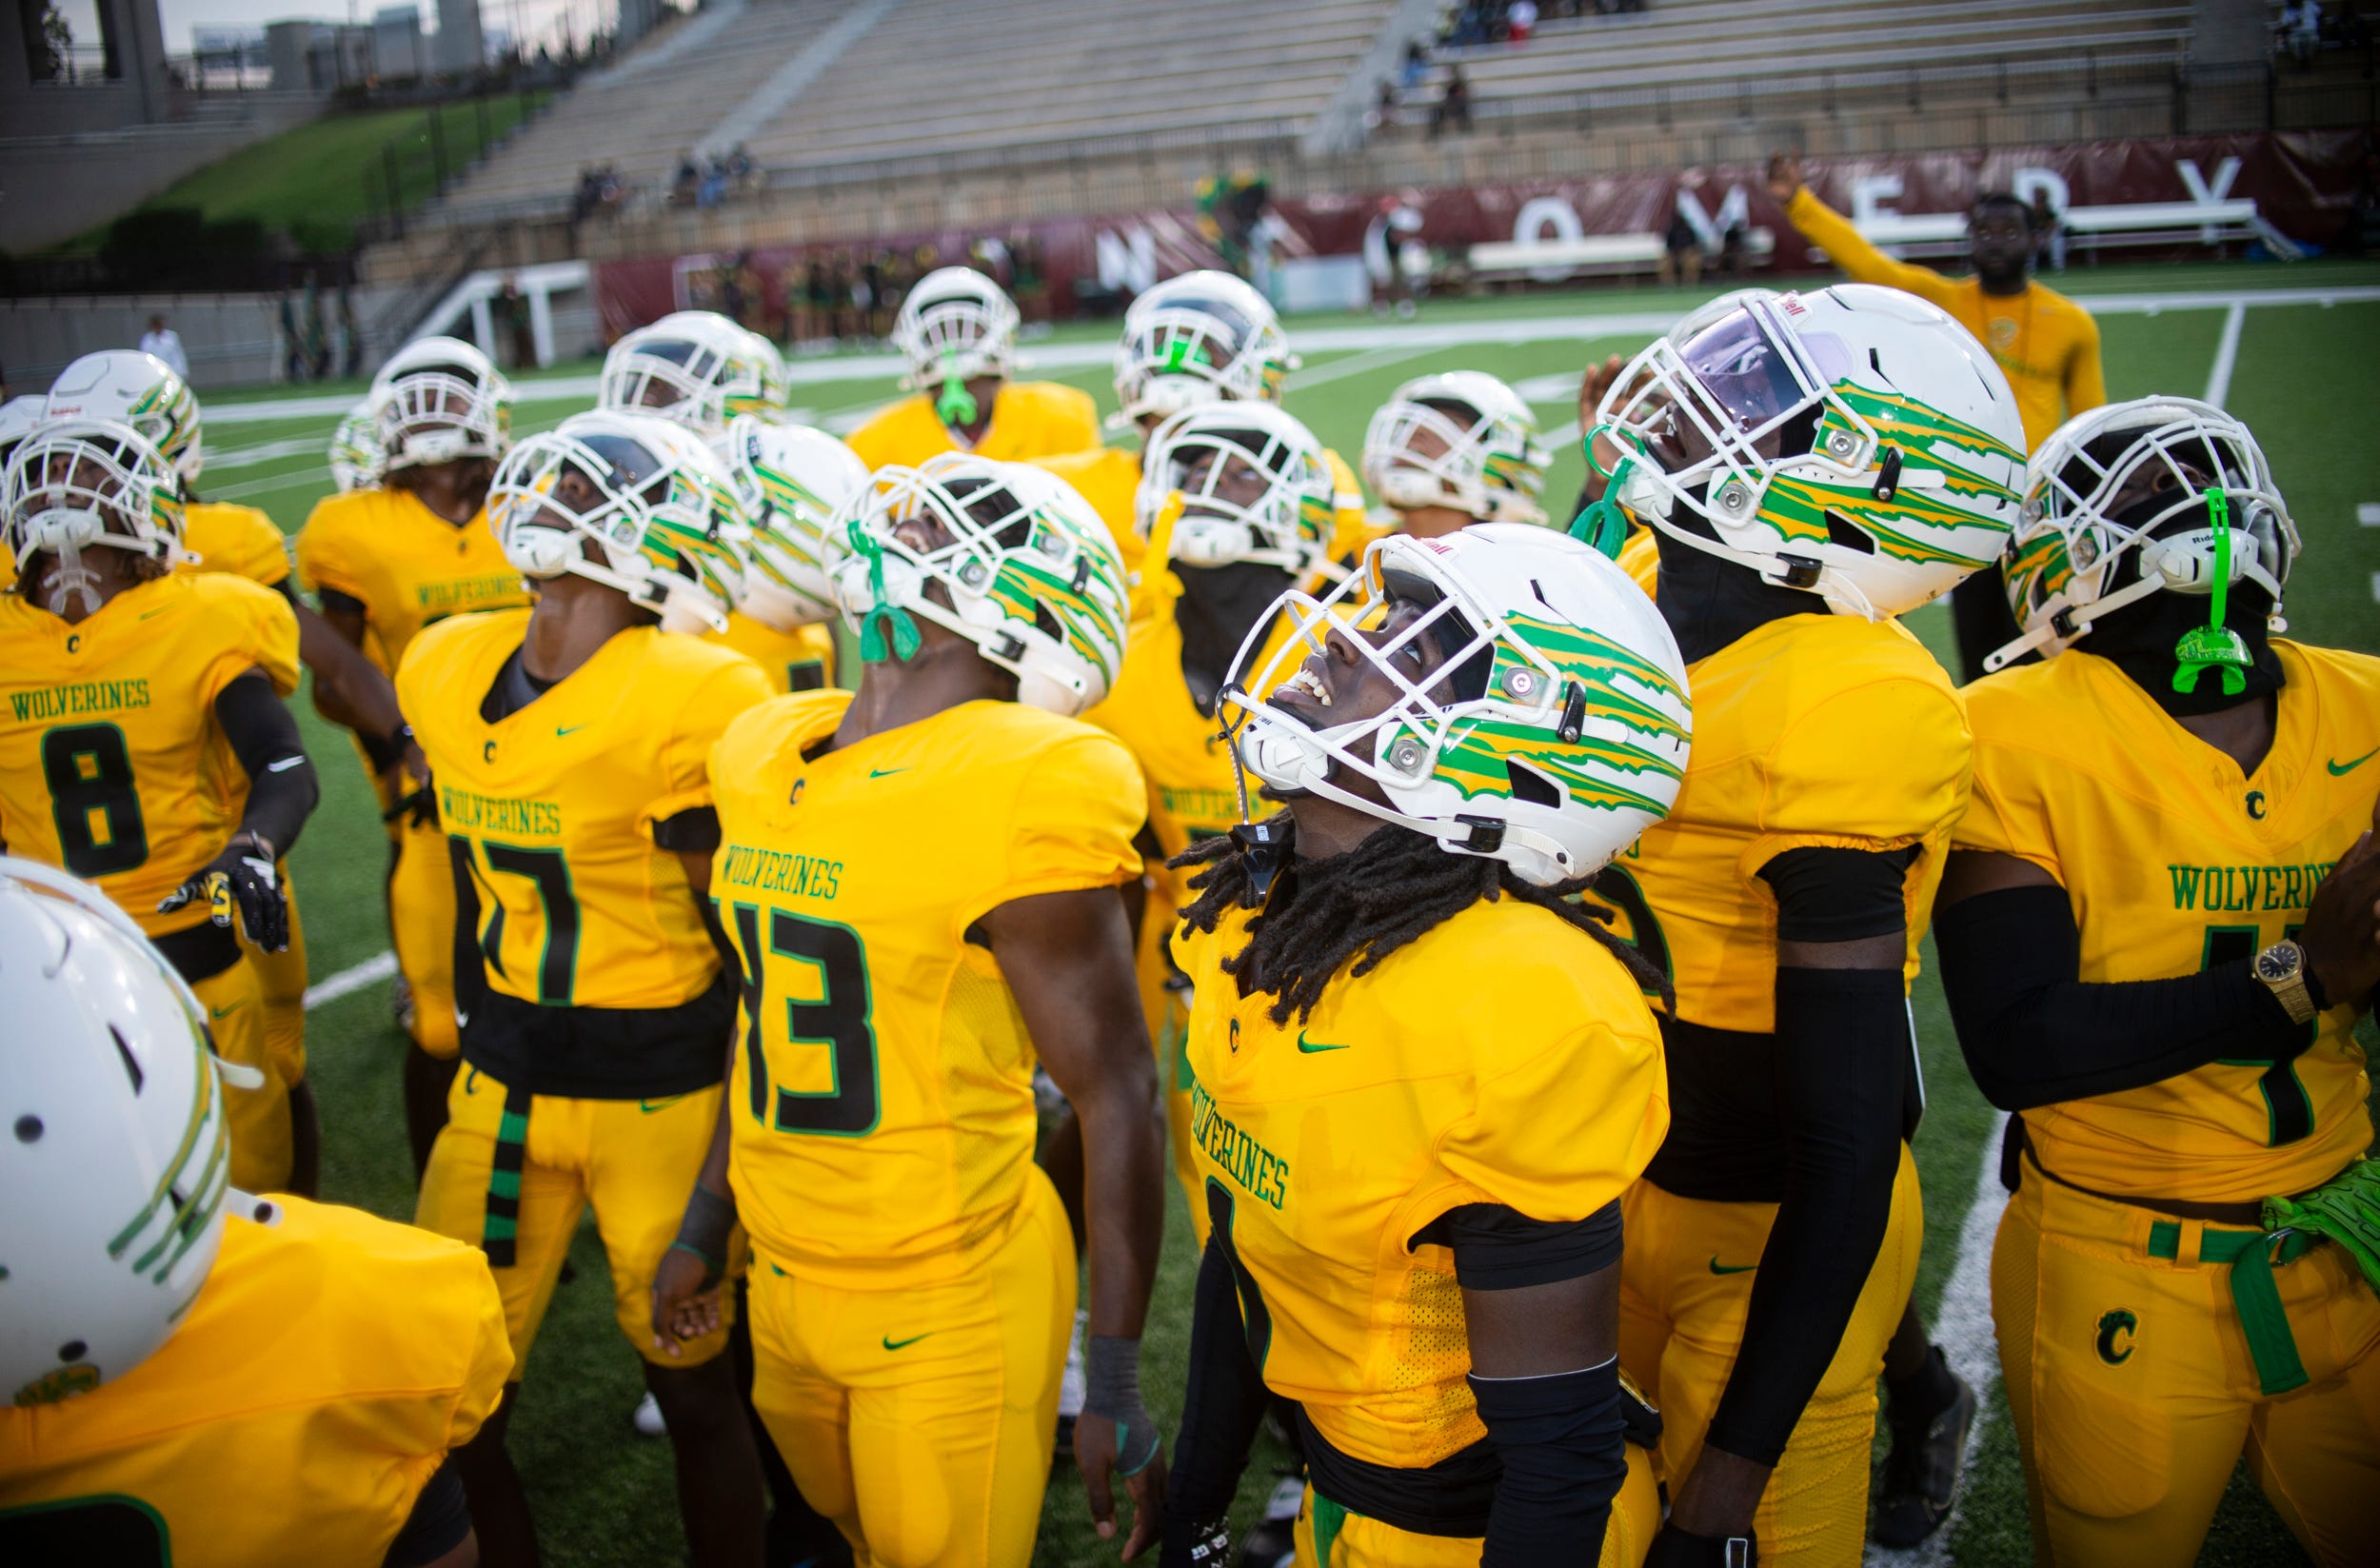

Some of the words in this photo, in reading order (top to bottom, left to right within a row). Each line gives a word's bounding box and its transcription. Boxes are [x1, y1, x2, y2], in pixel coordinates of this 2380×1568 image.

[10, 678, 150, 723] WOLVERINES
[40, 721, 149, 879] 8
[442, 785, 561, 836] WOLVERINES
[724, 844, 844, 900] WOLVERINES
